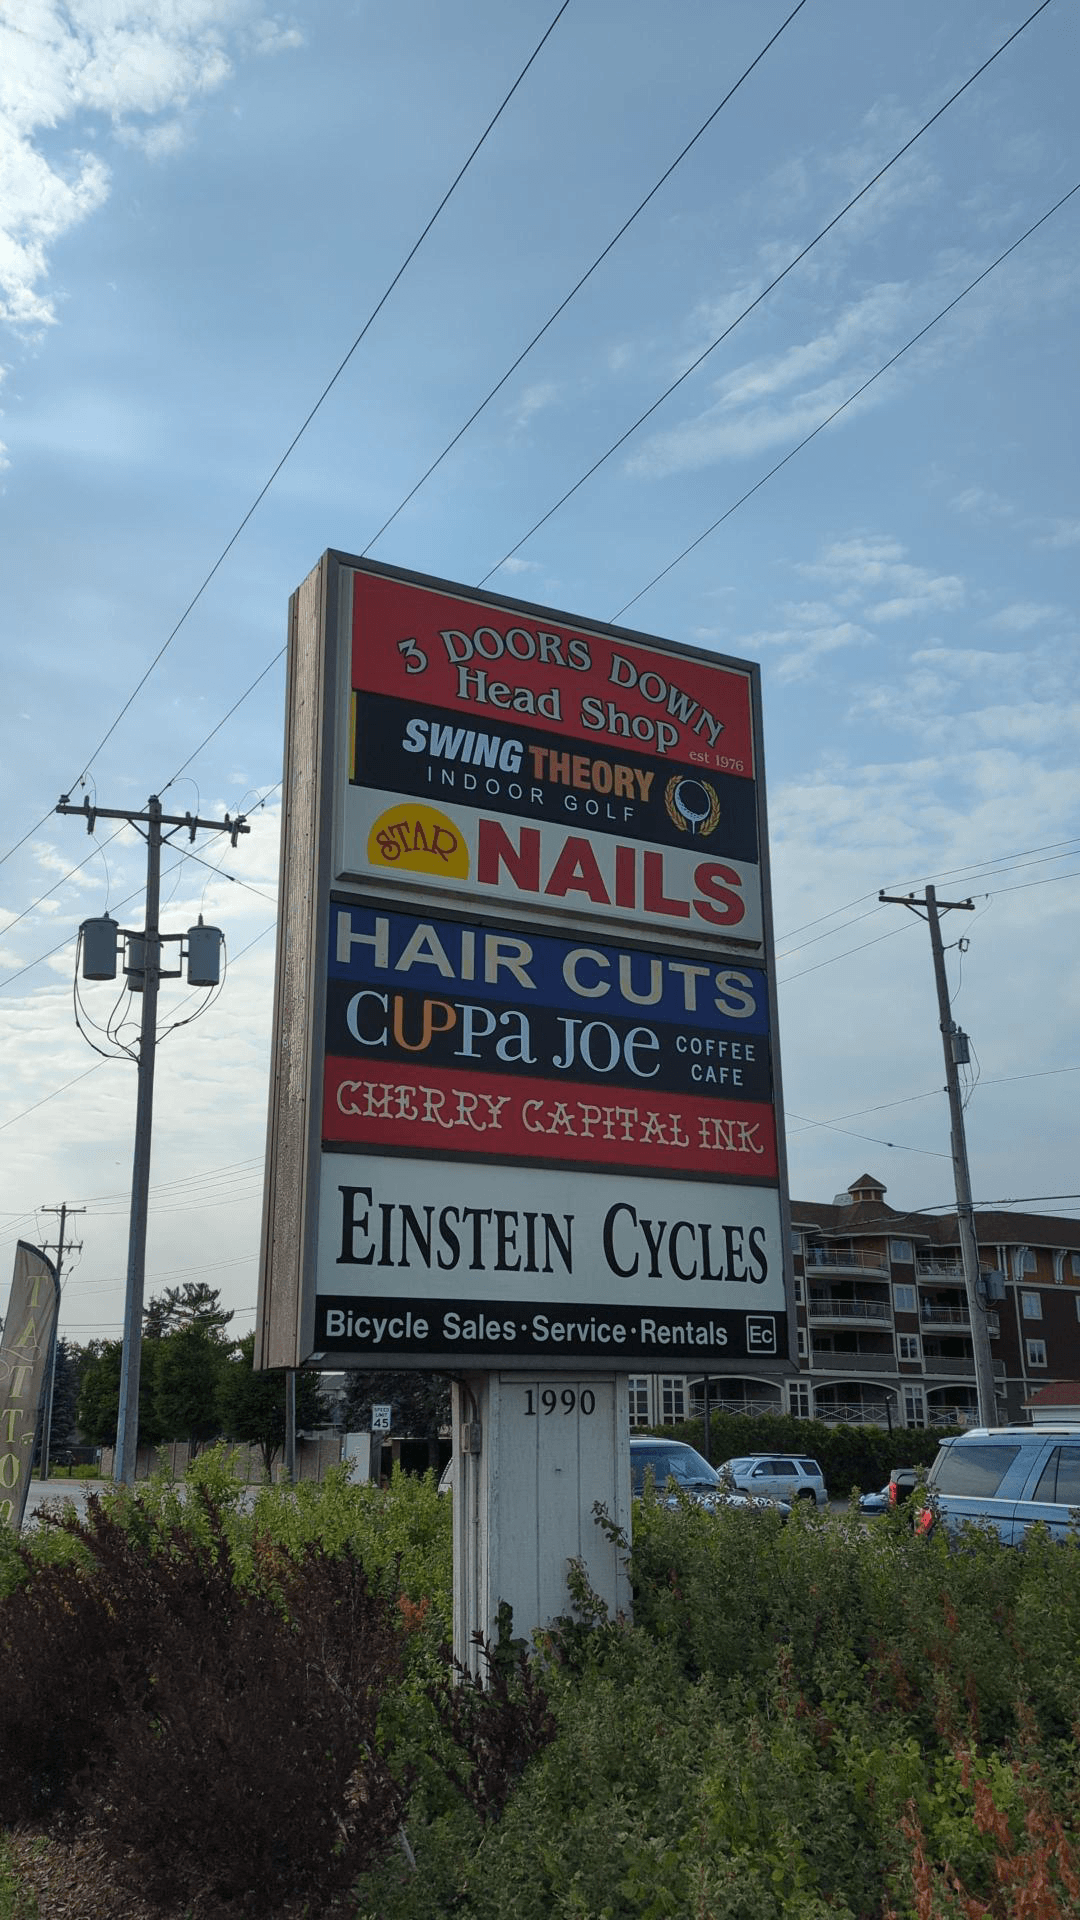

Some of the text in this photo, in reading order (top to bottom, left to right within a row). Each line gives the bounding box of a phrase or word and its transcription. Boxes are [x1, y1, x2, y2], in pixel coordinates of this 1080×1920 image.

[398, 626, 725, 747] 3 DOORS DOWN
[456, 665, 679, 753] Head Shop
[402, 718, 655, 802] SWING THEORY
[689, 751, 744, 772] est 1976
[427, 766, 635, 822] INDOOR GOLF
[375, 818, 745, 926] STAR NAILS
[336, 911, 757, 1019] HAIR CUTS
[675, 1035, 756, 1062] COFFEE
[691, 1064, 744, 1086] CAFE
[336, 1080, 765, 1154] CHERRY CAPITAL INK
[336, 1185, 768, 1285] EINSTEIN CYCLES
[326, 1309, 429, 1344] Bicycle
[373, 1418, 389, 1428] 45
[524, 1389, 596, 1416] 1990
